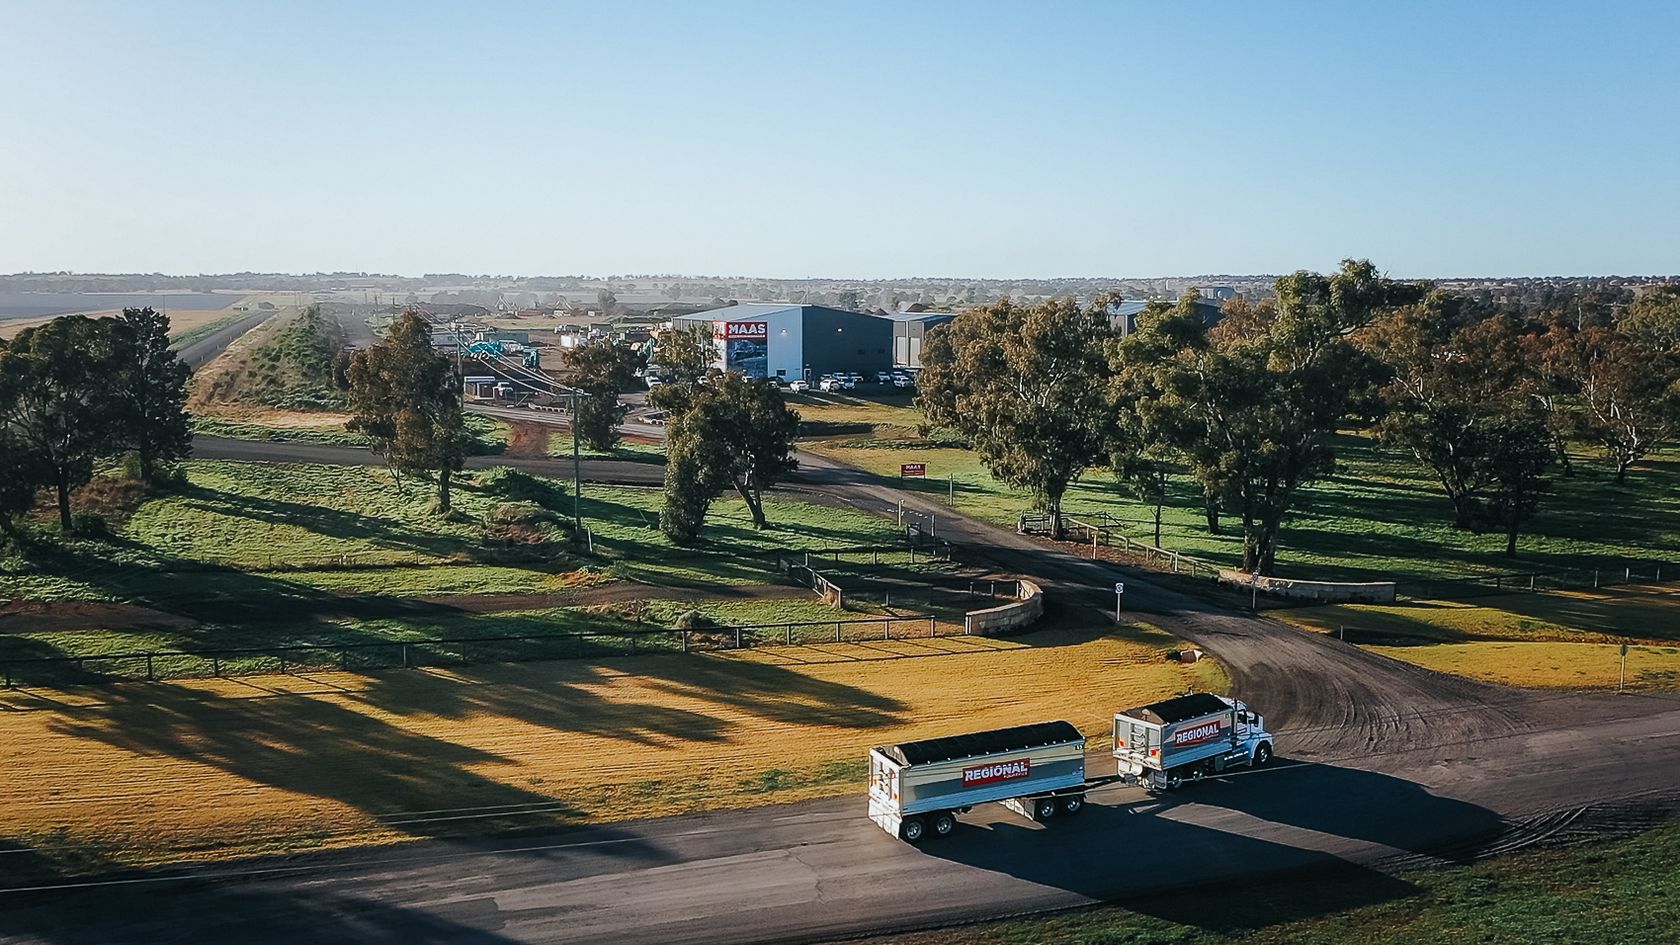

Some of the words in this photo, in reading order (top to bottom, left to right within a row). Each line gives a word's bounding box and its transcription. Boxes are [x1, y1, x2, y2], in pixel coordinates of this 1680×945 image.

[728, 324, 766, 334] MAAS
[1176, 724, 1219, 744] REGIONAL
[964, 761, 1028, 782] REGIONAL
